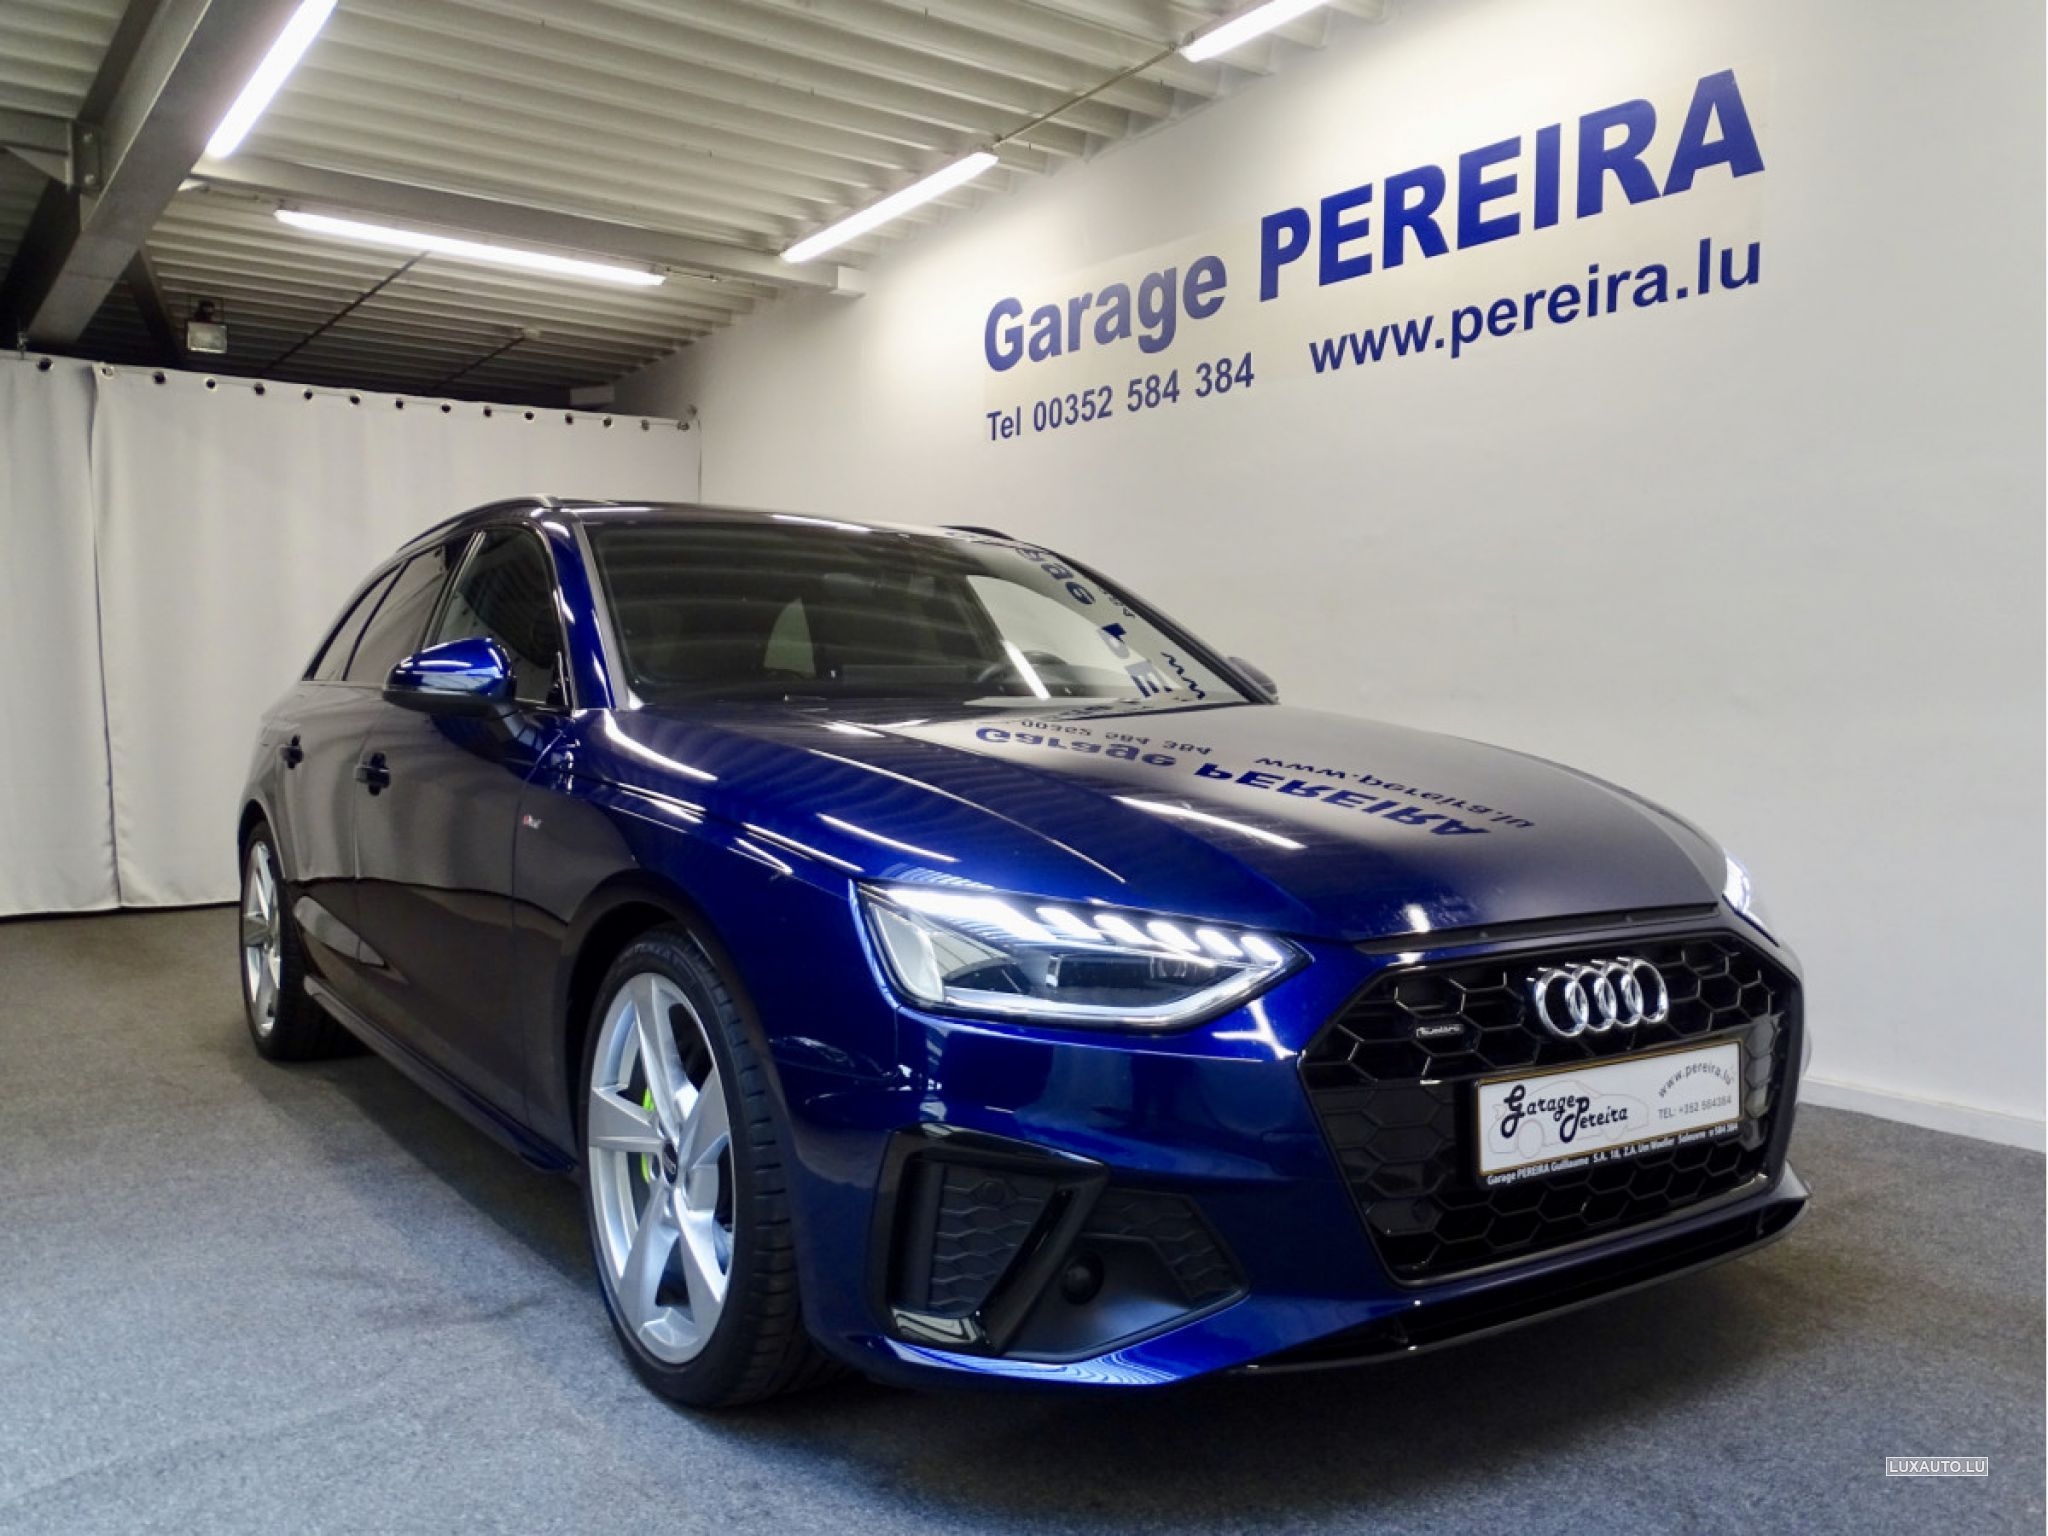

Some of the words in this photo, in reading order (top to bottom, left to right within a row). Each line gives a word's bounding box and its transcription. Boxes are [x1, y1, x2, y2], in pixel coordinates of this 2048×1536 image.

[984, 253, 1227, 373] Garage
[1259, 68, 1765, 302] PEREIRA
[986, 404, 1022, 442] Tel
[1033, 386, 1113, 433] 00352
[1126, 372, 1181, 413] 584
[1195, 352, 1256, 398] 384
[1309, 238, 1762, 375] www.pereira.lu
[1500, 1084, 1576, 1139] Garage
[1560, 1096, 1628, 1144] Pereira
